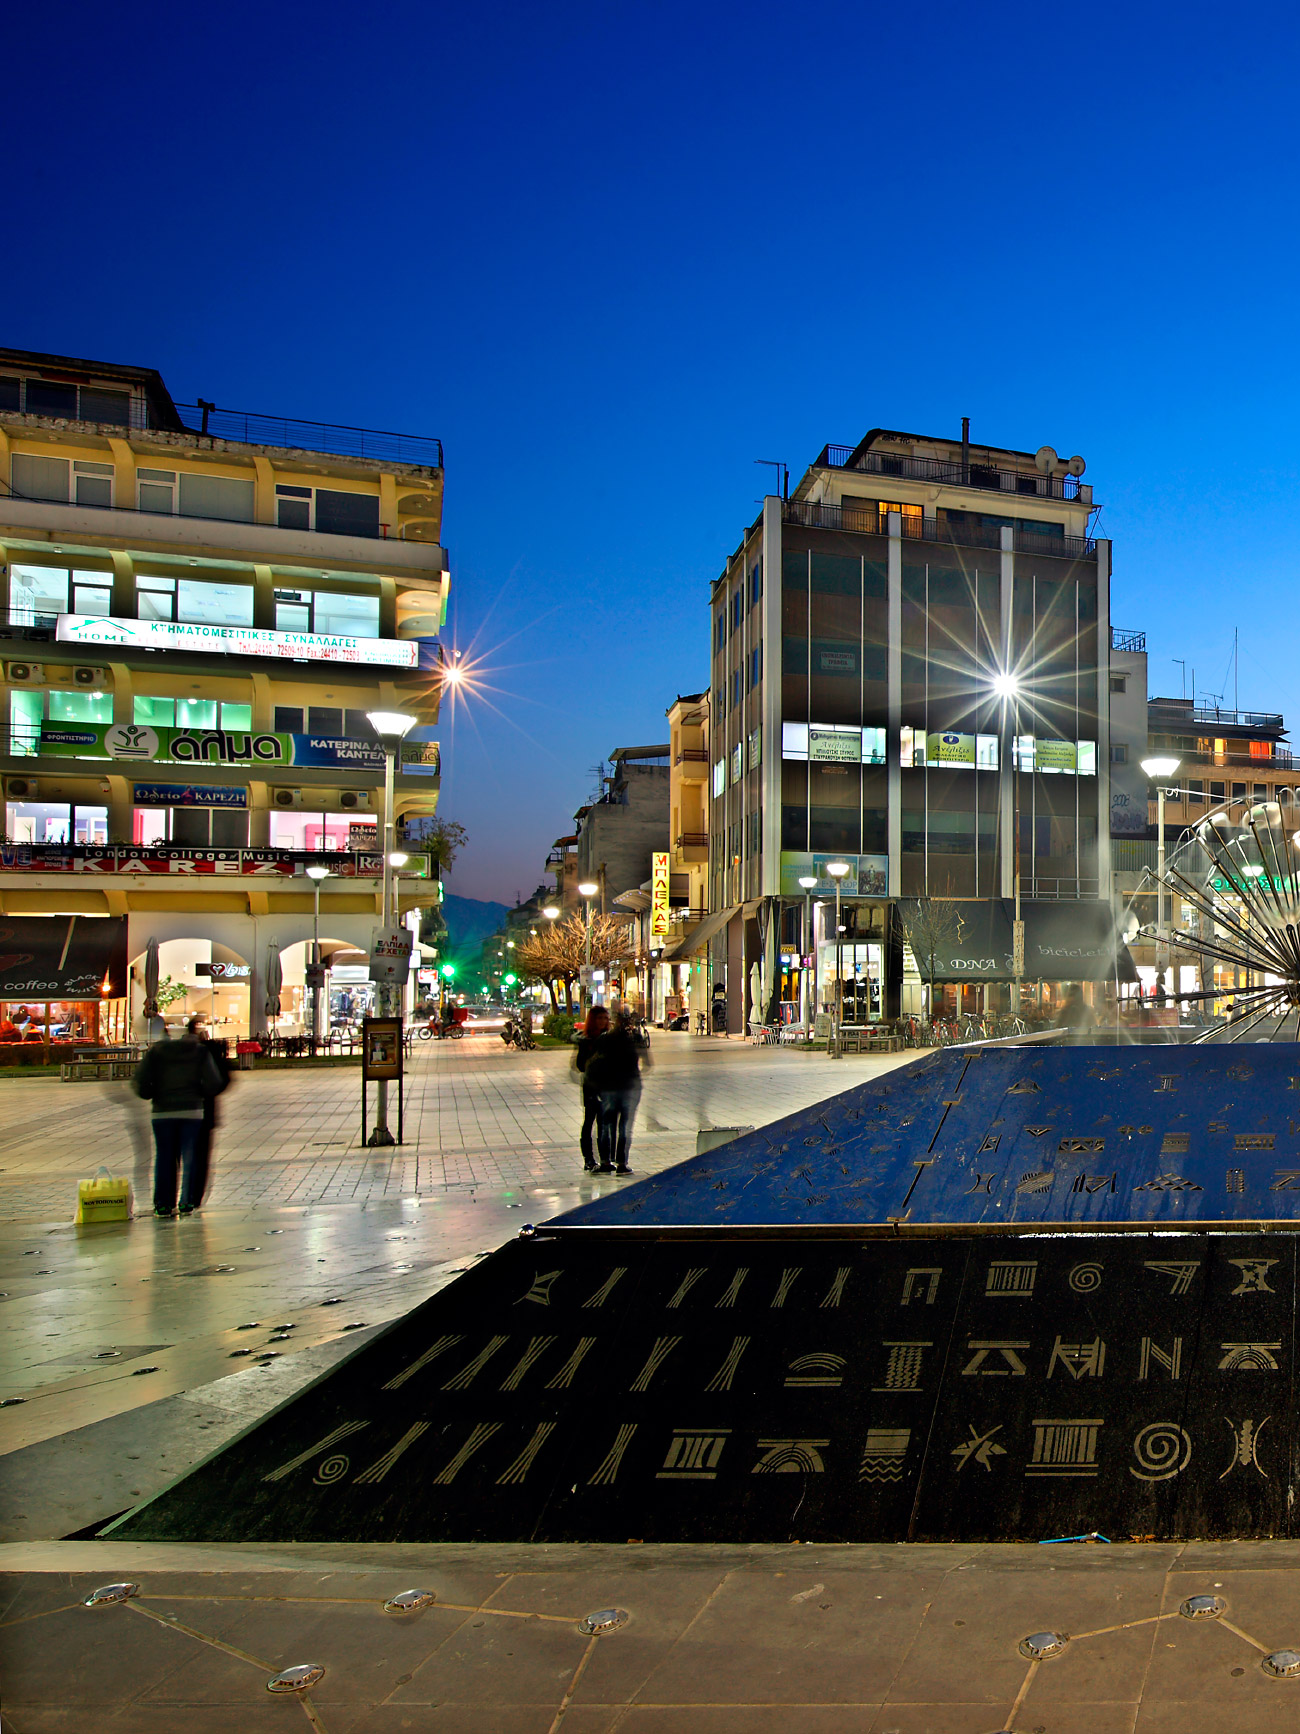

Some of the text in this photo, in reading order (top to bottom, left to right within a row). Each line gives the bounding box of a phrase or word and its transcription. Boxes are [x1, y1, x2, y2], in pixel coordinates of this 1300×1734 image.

[78, 632, 128, 643] HOME
[151, 623, 359, 648] ΚΤΗΜΑΤΟΜΕΣΙΤΙΚΕΣ ΣΥΝΑΛΛΑΓΕΣ
[47, 734, 94, 742] ΦΡΟΝΤΙΣΤΗΡΙΟ
[310, 739, 371, 751] ΚΑΤΕΡΙΝΑ
[337, 749, 386, 760] ΚΑΝΤΕΛ
[195, 792, 245, 802] ΚΑΡΕΖΗ
[85, 848, 150, 858] London
[157, 850, 227, 861] College
[242, 851, 290, 861] Music
[73, 857, 305, 875] KAREZI
[654, 854, 668, 934] ΜΠΛΕΚΑΣ
[377, 940, 409, 949] ΕΛΠΙΔΑ
[375, 947, 410, 955] ΕΡΧΕΤΑΙ
[950, 958, 999, 970] DNA
[4, 980, 59, 990] coffee
